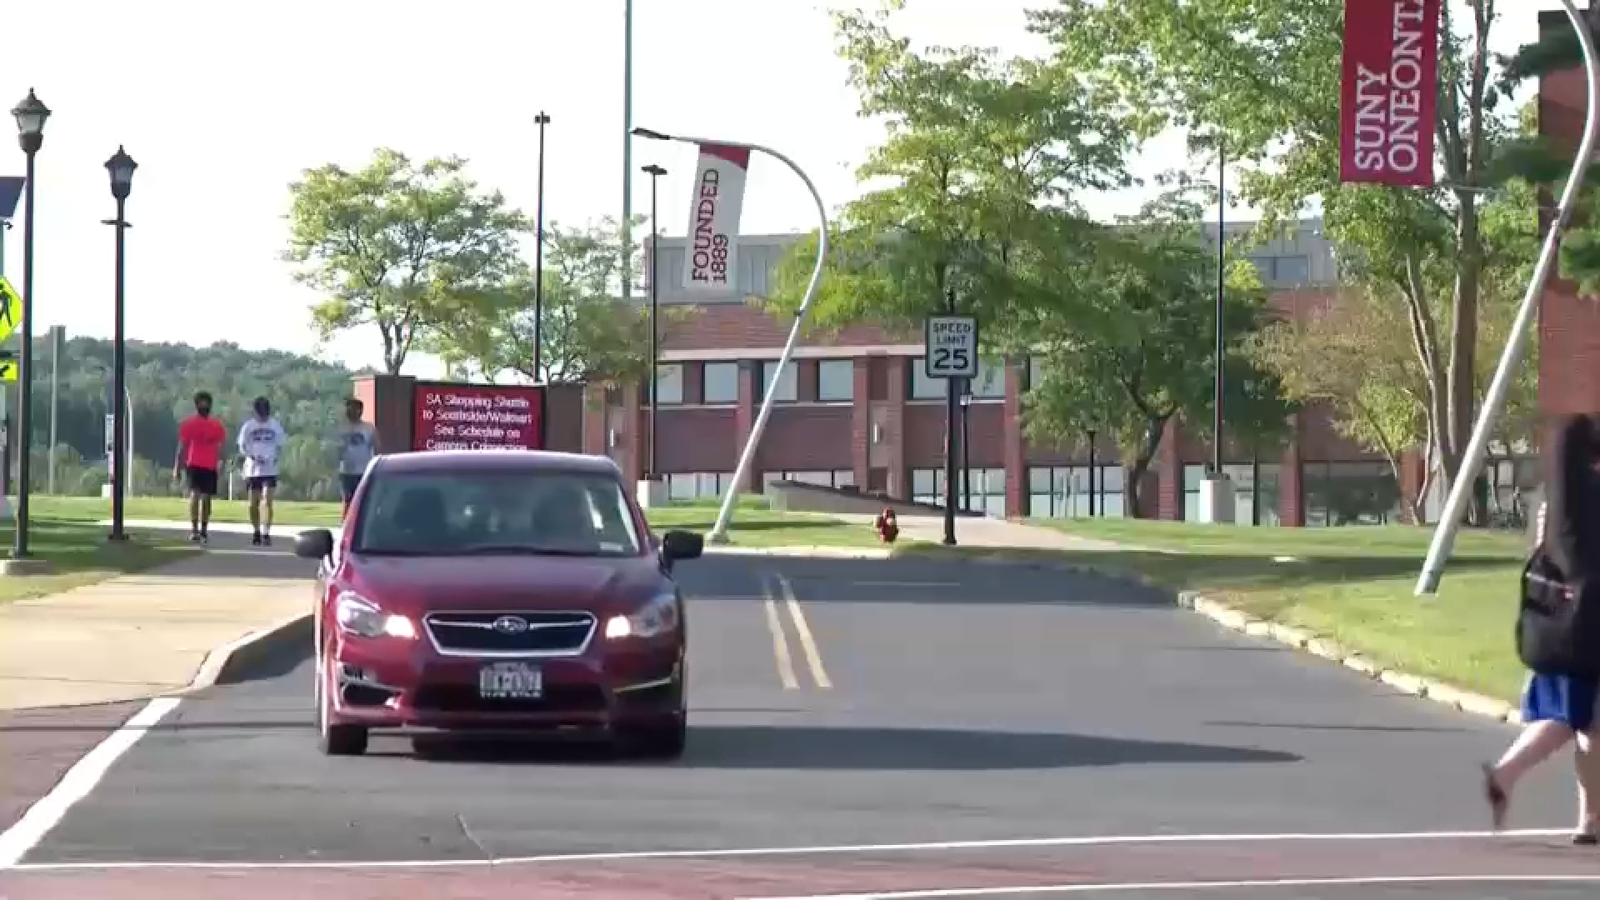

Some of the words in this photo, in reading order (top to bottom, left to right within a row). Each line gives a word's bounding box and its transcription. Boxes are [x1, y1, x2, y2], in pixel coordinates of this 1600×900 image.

[1388, 0, 1424, 173] ONEONT
[1355, 62, 1387, 171] SUNY
[692, 168, 719, 282] FOUNDED
[711, 233, 728, 282] 1889
[933, 322, 971, 333] SPEED
[937, 335, 967, 346] LIMIT
[934, 348, 969, 369] 25
[426, 393, 441, 405] SA
[444, 394, 492, 408] Shopping
[434, 423, 454, 435] See
[459, 425, 504, 438] Schedule
